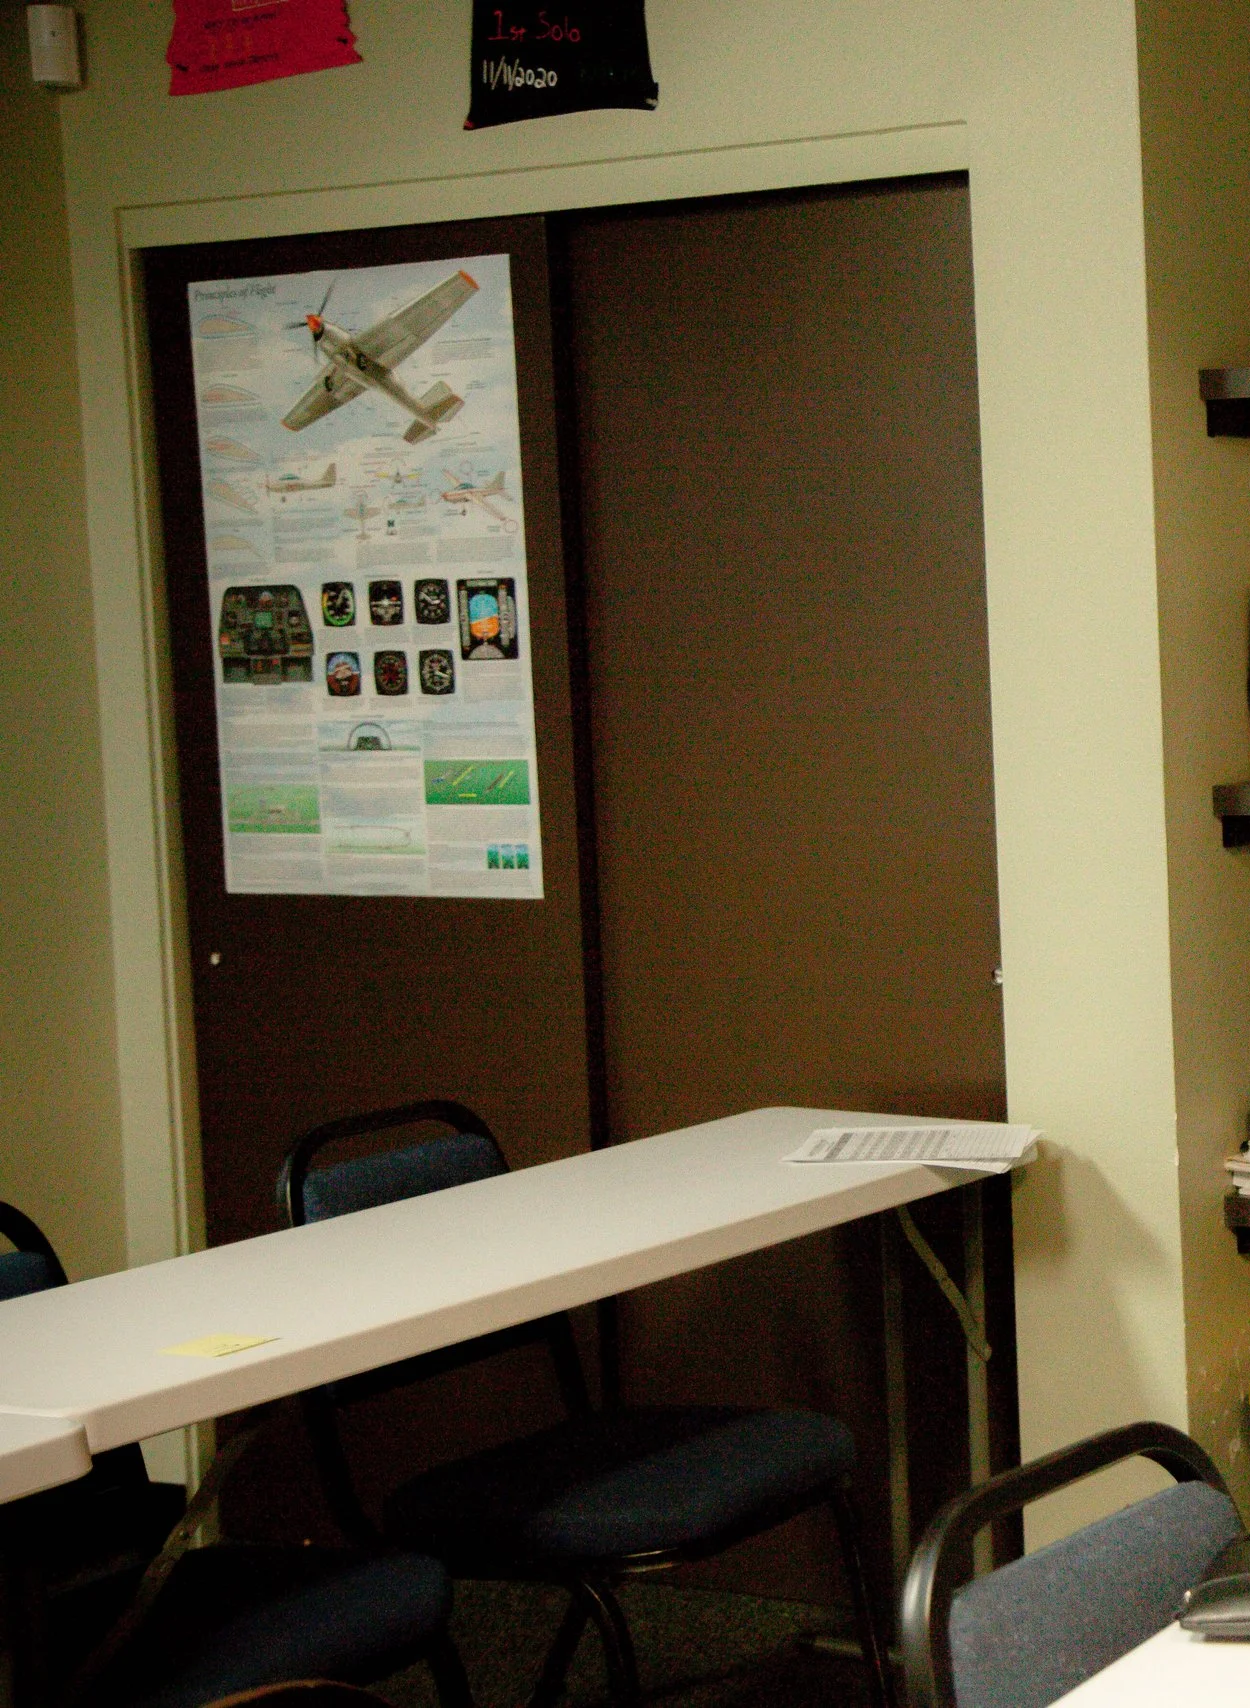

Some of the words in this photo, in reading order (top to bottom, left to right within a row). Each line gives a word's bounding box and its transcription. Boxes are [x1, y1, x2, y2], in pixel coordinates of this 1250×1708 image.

[535, 11, 581, 42] Solo
[483, 56, 558, 91] 11/11/2020
[194, 286, 238, 302] Principles
[250, 283, 276, 299] Flight
